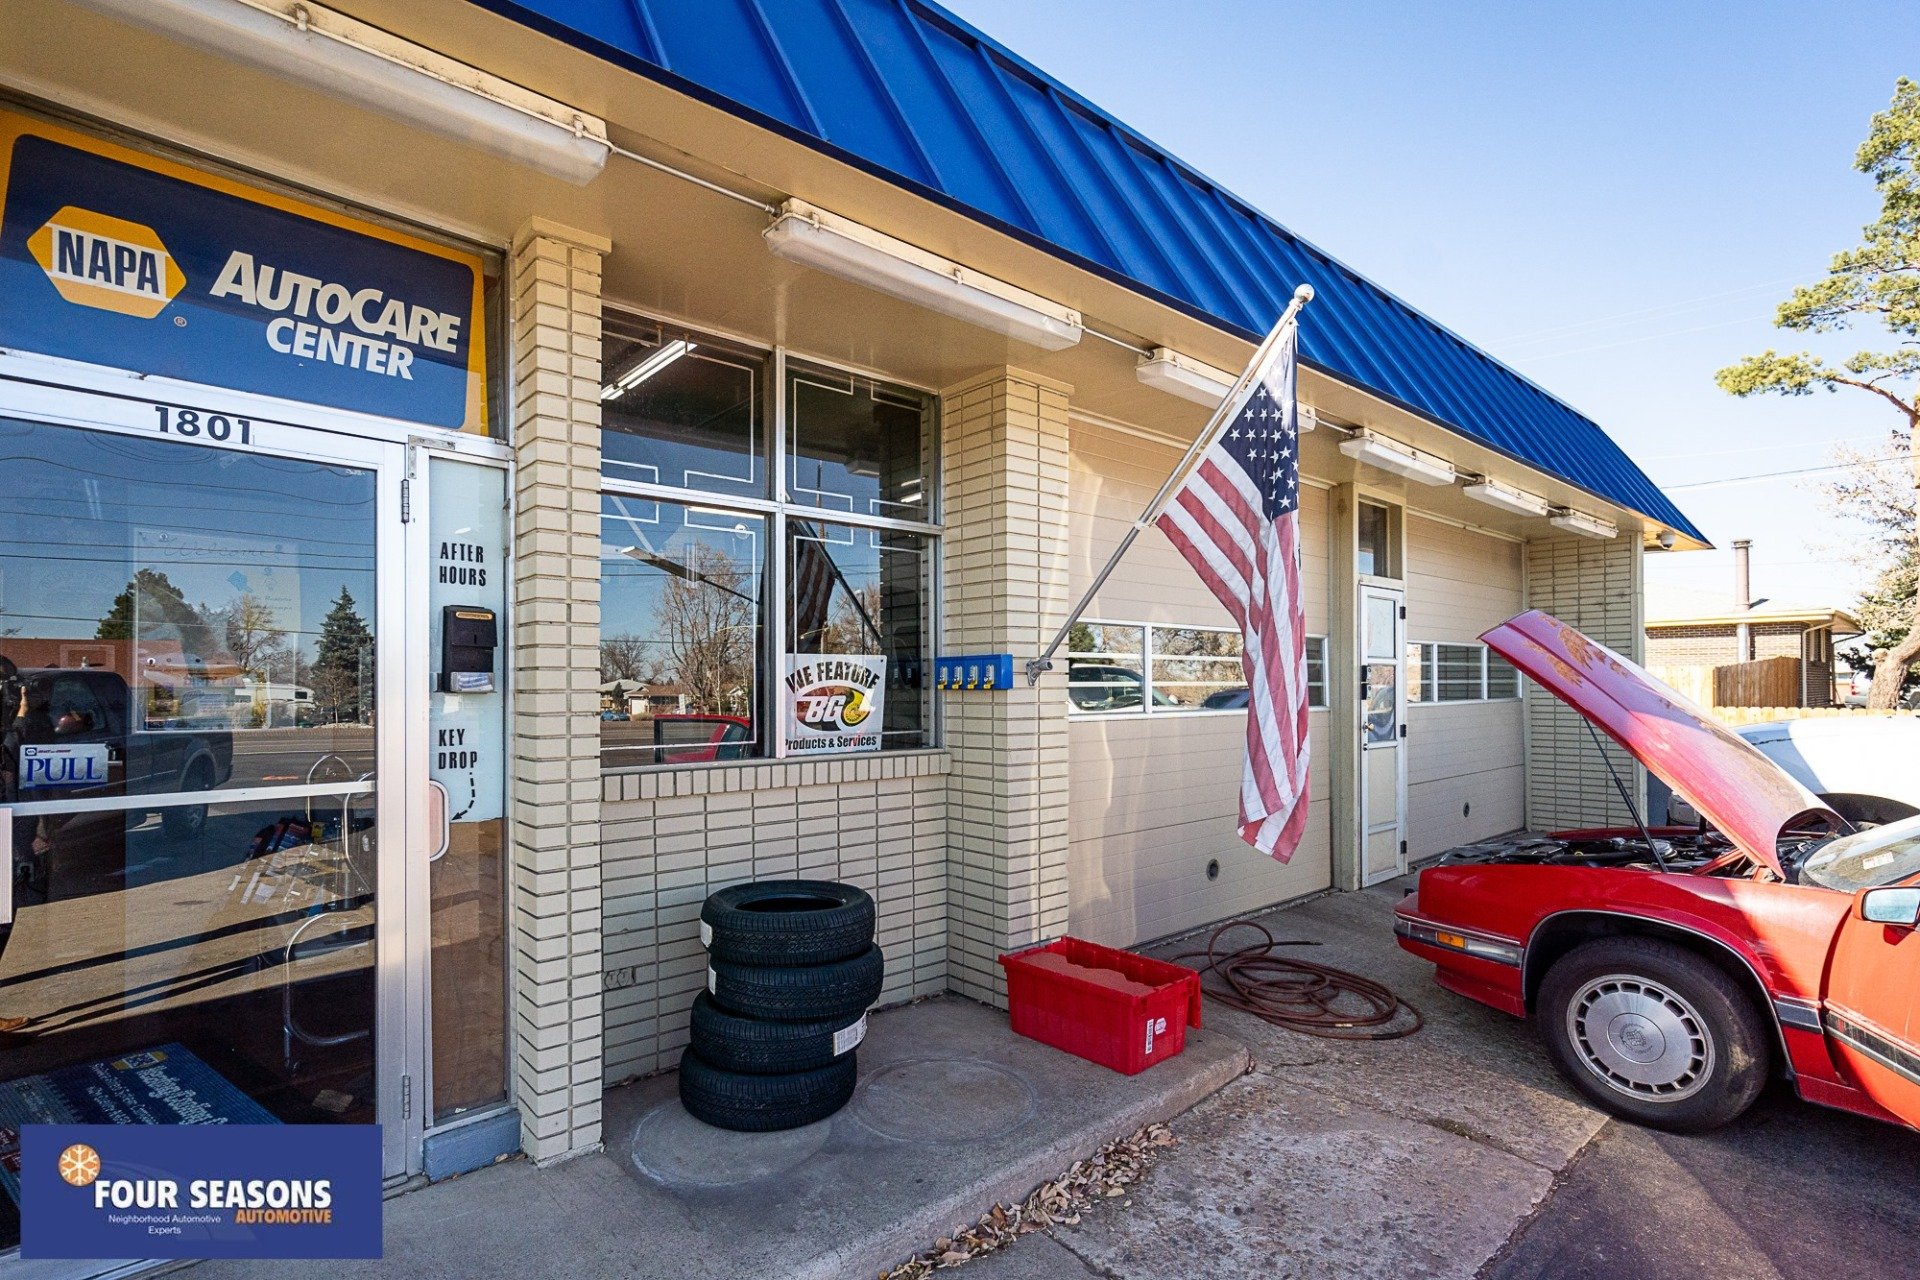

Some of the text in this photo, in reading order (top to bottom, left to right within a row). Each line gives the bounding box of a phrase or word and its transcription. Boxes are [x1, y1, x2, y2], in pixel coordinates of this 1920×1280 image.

[58, 229, 160, 295] NAPA
[266, 317, 414, 381] CENTER
[155, 405, 253, 445] 1801
[440, 541, 484, 563] AFTER
[439, 565, 487, 586] HOURS
[785, 665, 814, 694] WE
[816, 661, 880, 690] FEATURE
[800, 695, 847, 723] BG
[438, 728, 466, 747] KEY
[828, 738, 835, 748] &
[837, 734, 877, 748] Services
[25, 757, 104, 783] PULL
[438, 751, 478, 770] DROP
